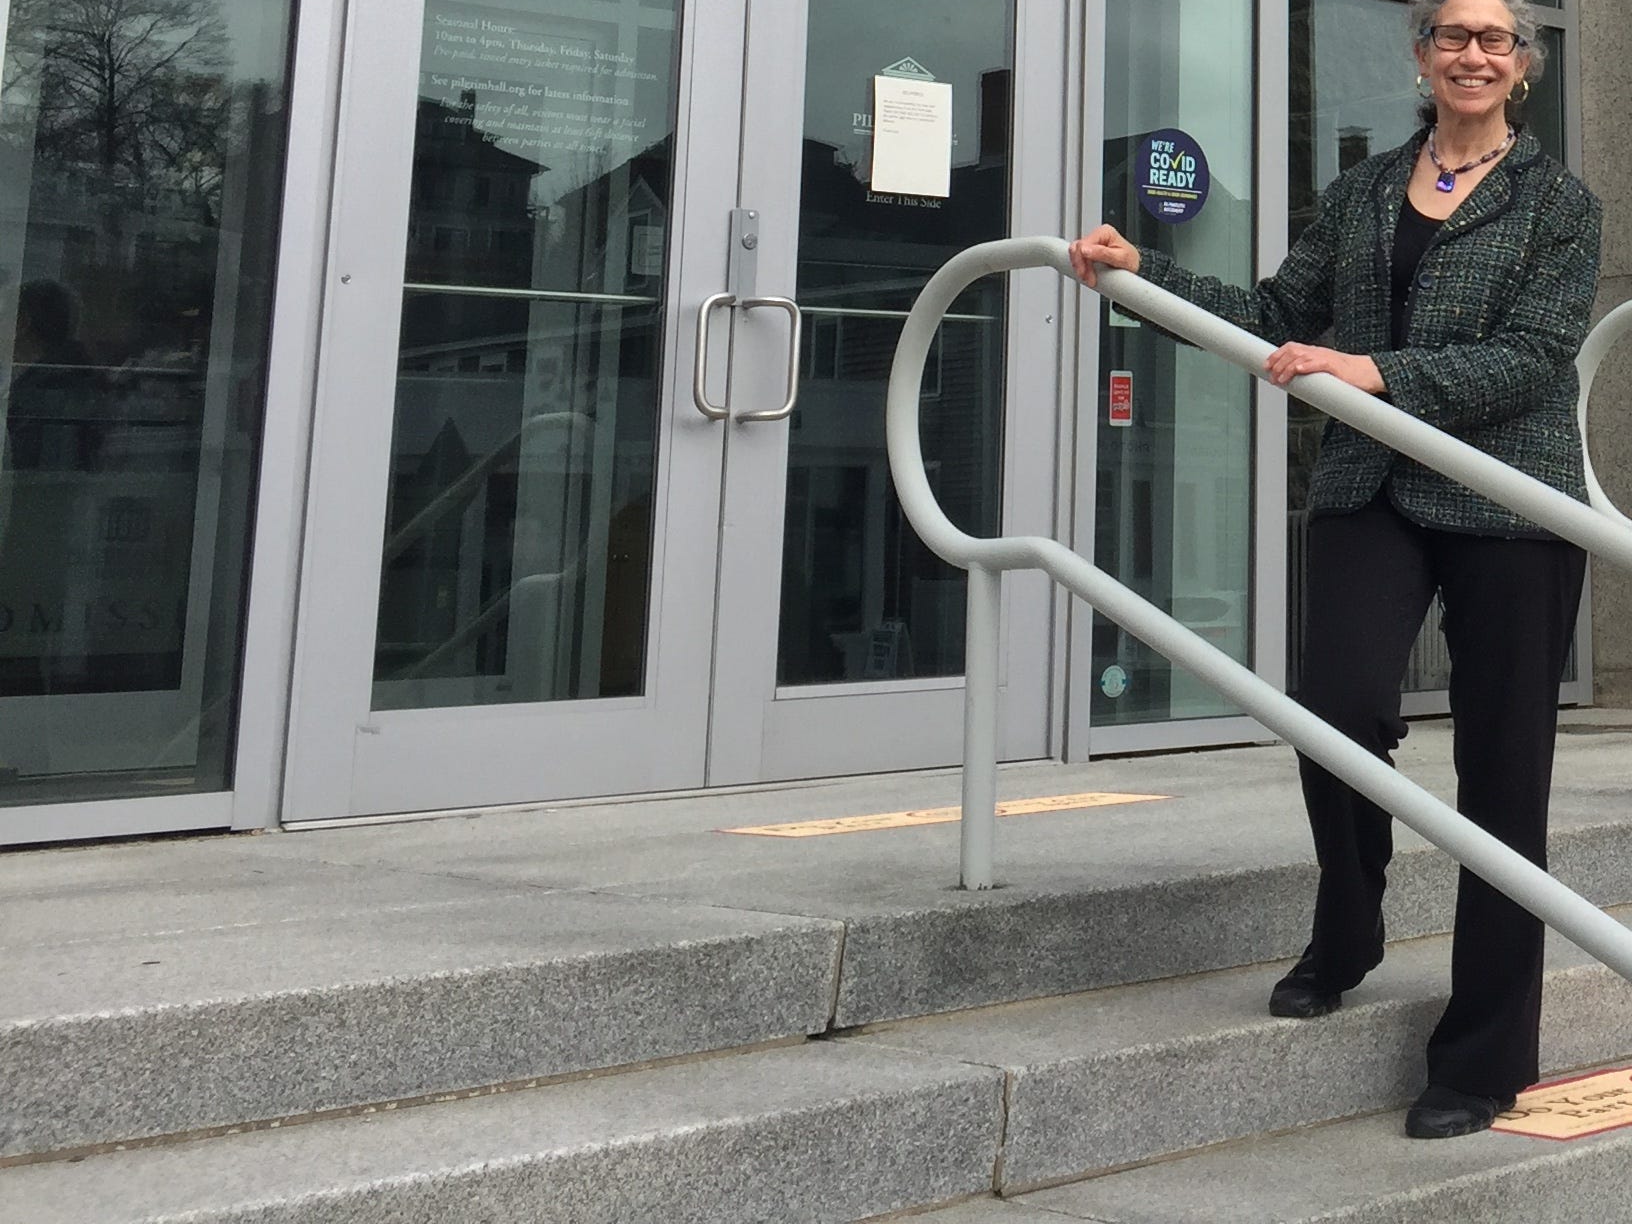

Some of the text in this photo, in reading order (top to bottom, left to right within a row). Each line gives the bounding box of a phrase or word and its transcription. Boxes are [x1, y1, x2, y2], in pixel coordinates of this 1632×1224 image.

[465, 35, 477, 44] to
[594, 49, 635, 66] Saturday
[431, 74, 448, 86] See
[451, 77, 526, 96] pilgrimhall.org
[528, 84, 542, 96] for
[1151, 139, 1176, 153] WE'RE
[1149, 168, 1196, 189] READY
[866, 190, 894, 205] Enter
[1496, 1087, 1632, 1121] Do Your
